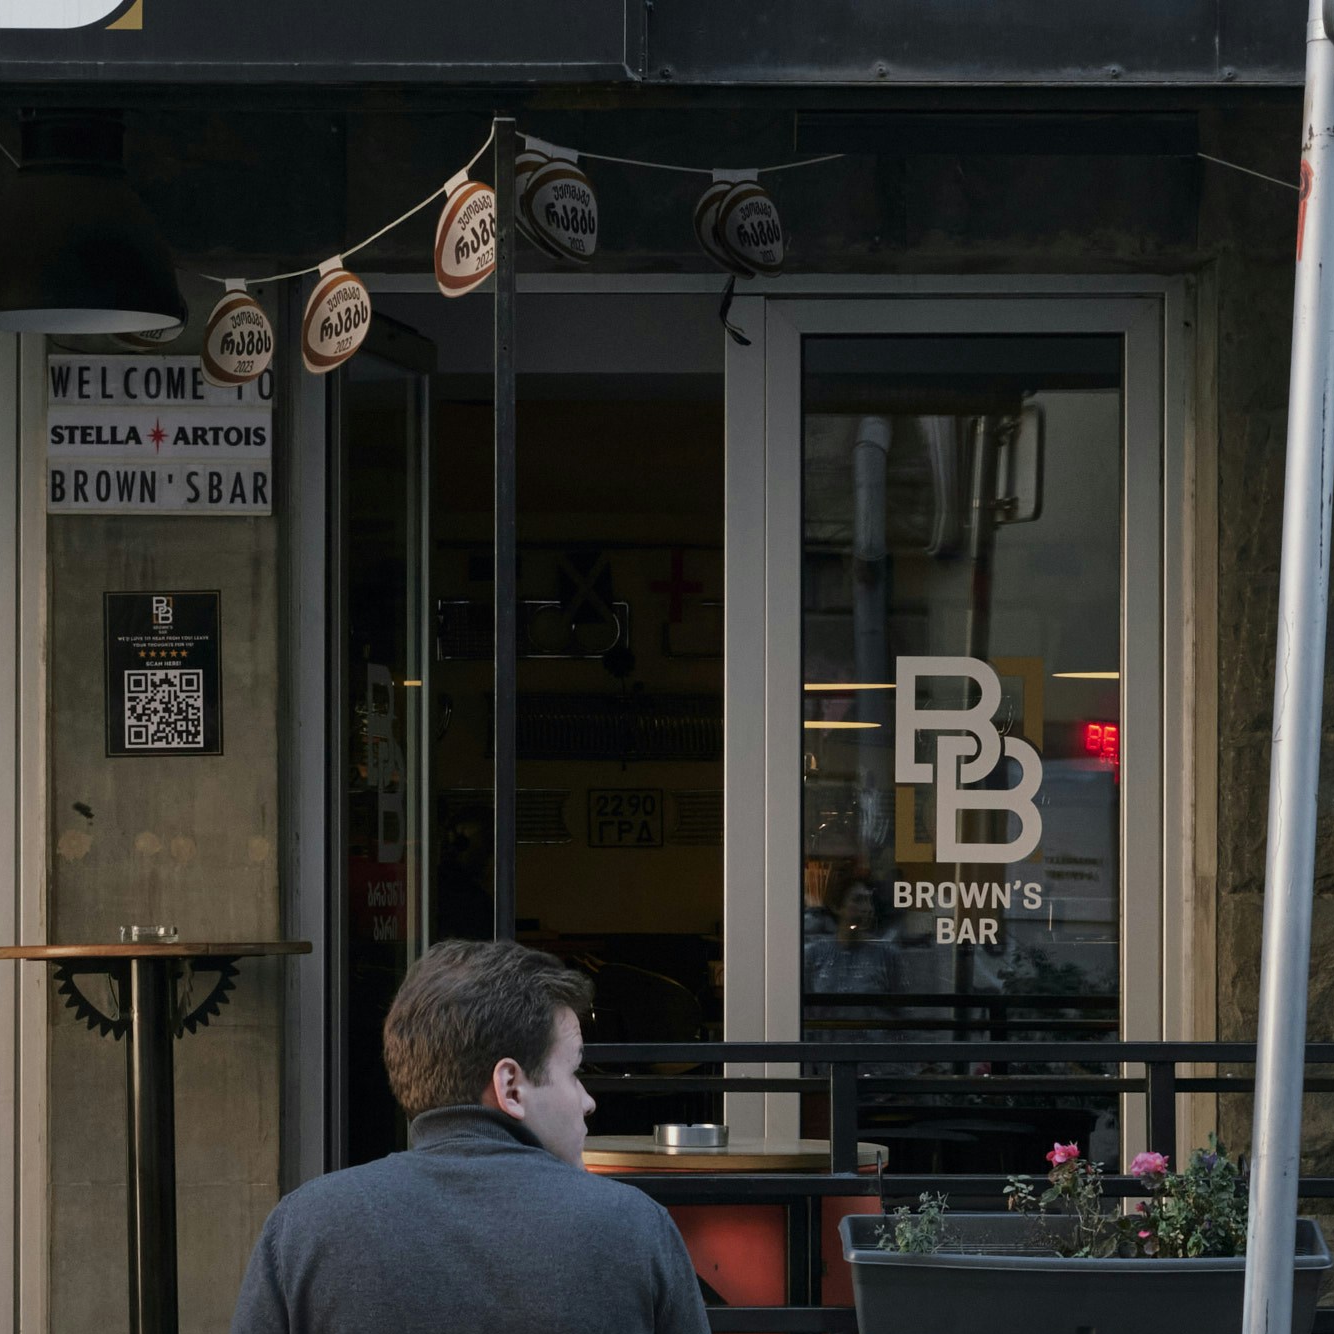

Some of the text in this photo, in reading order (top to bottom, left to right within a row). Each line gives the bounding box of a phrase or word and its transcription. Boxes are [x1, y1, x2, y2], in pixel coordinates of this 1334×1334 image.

[545, 203, 596, 235] რაგბს
[736, 219, 780, 247] რაგბს
[320, 300, 368, 342] რაგბს
[220, 330, 272, 355] რაგბს
[233, 361, 255, 373] 2023
[50, 366, 204, 400] WELCOME
[50, 425, 267, 447] STELLA ARTOIS
[595, 795, 657, 816] 2290
[893, 880, 1042, 910] BROWN'S
[935, 917, 999, 945] BAR
